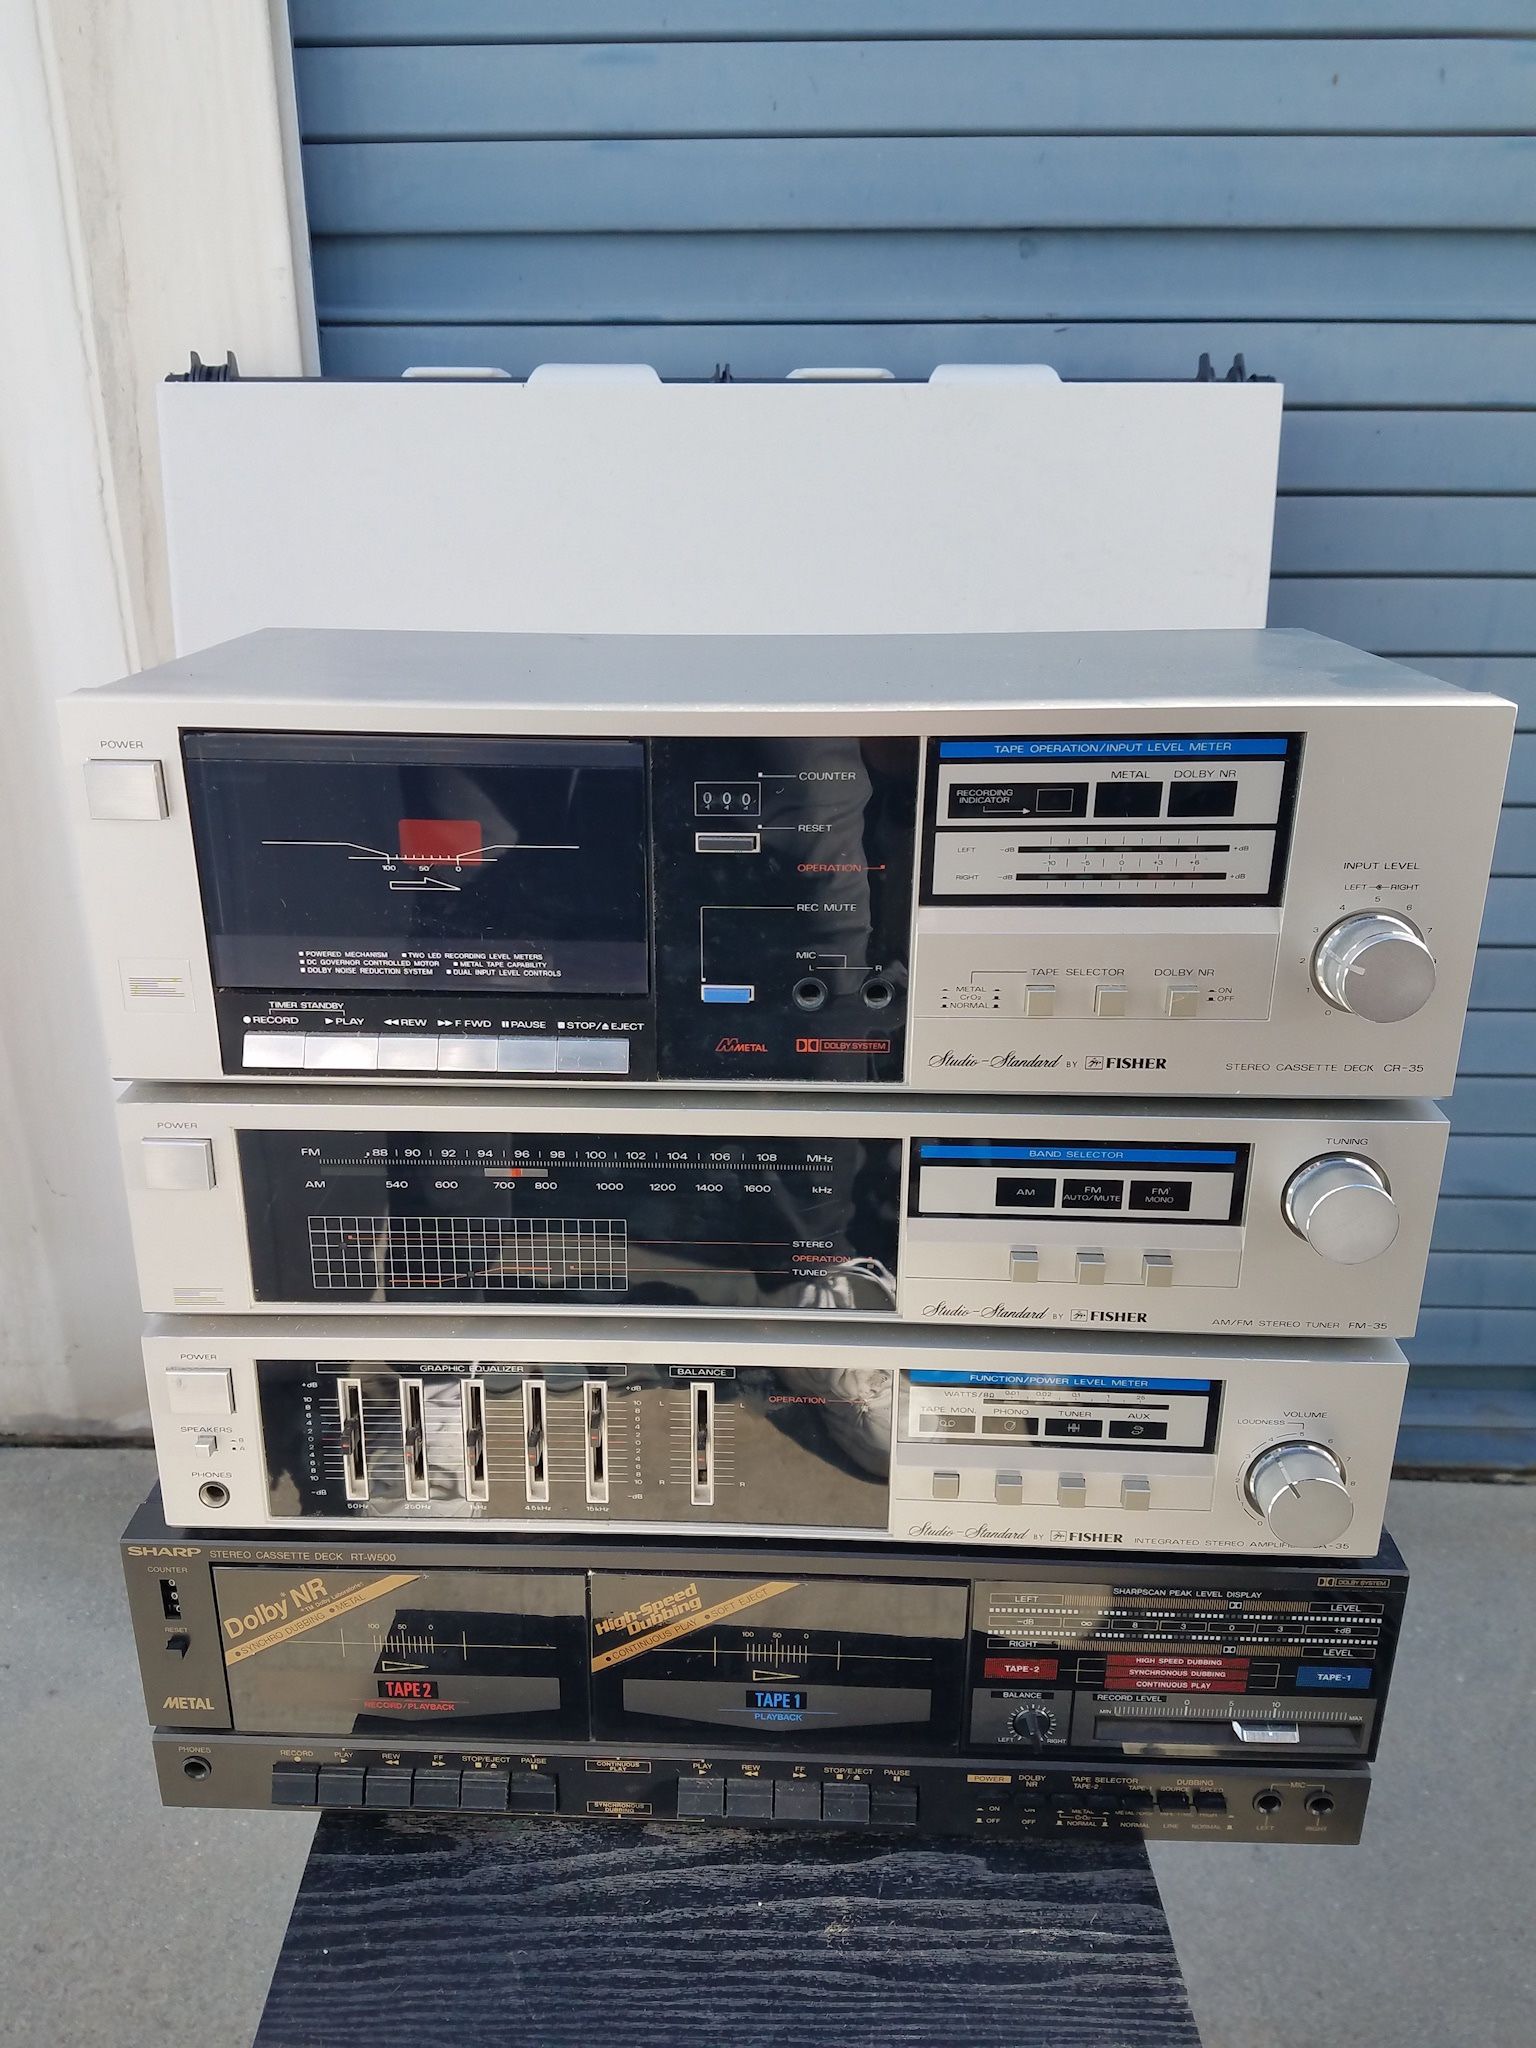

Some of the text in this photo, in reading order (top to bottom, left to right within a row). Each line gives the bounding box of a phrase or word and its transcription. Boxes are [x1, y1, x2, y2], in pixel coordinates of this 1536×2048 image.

[100, 740, 144, 749] POWER
[994, 742, 1232, 754] TAPE OPERATION/INPUT LEVEL METER
[799, 772, 856, 781] COUNTER
[1111, 770, 1150, 779] METAL
[1174, 769, 1237, 779] DOLBY NR
[956, 789, 1013, 797] RECORDING
[959, 796, 1010, 804] INDICATOR
[798, 824, 832, 833] RESET
[797, 864, 862, 873] OPERATION
[1343, 862, 1421, 870] INPUT LEVEL
[796, 904, 857, 912] REC MUTE
[407, 952, 424, 960] TWO
[427, 952, 442, 960] LED
[444, 952, 487, 960] RECORDING
[513, 953, 543, 961] METERS
[363, 959, 411, 967] CONTROLLED
[460, 960, 484, 968] METAL
[506, 961, 547, 969] CAPABILITY
[307, 967, 332, 975] DOLBY
[335, 967, 357, 975] NOISE
[359, 967, 401, 975] REDUCTION
[1031, 968, 1125, 977] TAPE SELECTOR
[1154, 968, 1216, 977] DOLBY NR
[269, 1001, 344, 1010] TIMER STANDBY
[950, 1001, 990, 1009] NORMAL
[252, 1016, 299, 1025] RECORD
[335, 1017, 364, 1026] PLAY
[400, 1019, 427, 1027] REW
[510, 1020, 546, 1029] PAUSE
[1106, 1057, 1167, 1070] FISHER
[1225, 1062, 1424, 1073] STEREO CASSETTE DECK CR-35
[1326, 1137, 1369, 1146] TUNING
[301, 1148, 321, 1156] FM
[1029, 1150, 1124, 1159] BAND SELECTOR
[305, 1180, 326, 1188] AM
[386, 1180, 833, 1195] 540 600 700 800 1000 1200 1400 1600 kHz
[1016, 1188, 1036, 1196] AM
[1063, 1194, 1121, 1203] AUTO/MUTE
[1145, 1196, 1174, 1204] MONO
[792, 1240, 833, 1249] STEREO
[792, 1254, 851, 1263] OPERATION
[792, 1268, 828, 1277] TUNED
[1091, 1311, 1148, 1323] FISHER
[1212, 1319, 1388, 1330] AM/FM STEREO TUNER FM-35
[469, 1365, 524, 1373] EQUALIZER
[677, 1368, 727, 1377] BALANCE
[970, 1374, 1149, 1388] FUNCTION/POWER LEVEL METER
[769, 1396, 826, 1404] OPERATION
[921, 1406, 949, 1414] TAPE
[993, 1408, 1029, 1416] PHONO
[1058, 1410, 1092, 1418] TUNER
[1127, 1412, 1151, 1420] AUX
[1283, 1411, 1328, 1419] VOLUME
[1069, 1532, 1124, 1544] FISHER
[127, 1546, 397, 1562] SHARP STEREO CASSETTE DECK RT-W500
[147, 1566, 188, 1574] COUNTER
[289, 1578, 329, 1609] NR
[1113, 1587, 1263, 1599] SHARPSCAN PEAK LEVEL DISPLAY
[335, 1594, 366, 1611] METAL
[710, 1588, 769, 1618] SOFT EJECT
[595, 1583, 698, 1636] High-Speed
[1330, 1604, 1361, 1612] LEVEL
[627, 1597, 702, 1636] Dubbing
[241, 1613, 325, 1655] SYNCHRO DUBBING
[612, 1618, 698, 1660] CONTINUOUS PLAY
[1008, 1640, 1038, 1648] RIGHT
[1323, 1648, 1353, 1657] LEVEL
[1136, 1657, 1156, 1665] HIGH
[1187, 1658, 1223, 1666] DUBBING
[1004, 1665, 1040, 1673] TAPE-2
[1129, 1669, 1227, 1678] SYNCHRONOUS DUBBING
[385, 1681, 431, 1698] TAPE 2
[1136, 1681, 1211, 1690] CONTINUOUS PLAY
[1002, 1691, 1043, 1699] BALANCE
[1097, 1694, 1163, 1703] RECORD LEVEL
[162, 1696, 215, 1710] METAL
[755, 1692, 800, 1708] TAPE 1
[363, 1701, 456, 1711] RECORD/PLAYBACK
[754, 1712, 802, 1722] PLAYBACK
[280, 1749, 314, 1757] RECORD
[461, 1755, 511, 1764] STOP/EJECT
[520, 1757, 547, 1766] PAUSE
[823, 1767, 874, 1776] STOP/EJECT
[884, 1769, 910, 1777] PAUSE
[1018, 1774, 1046, 1782] DOLBY
[1094, 1776, 1139, 1784] SELECTOR
[1177, 1779, 1214, 1787] DUBBING
